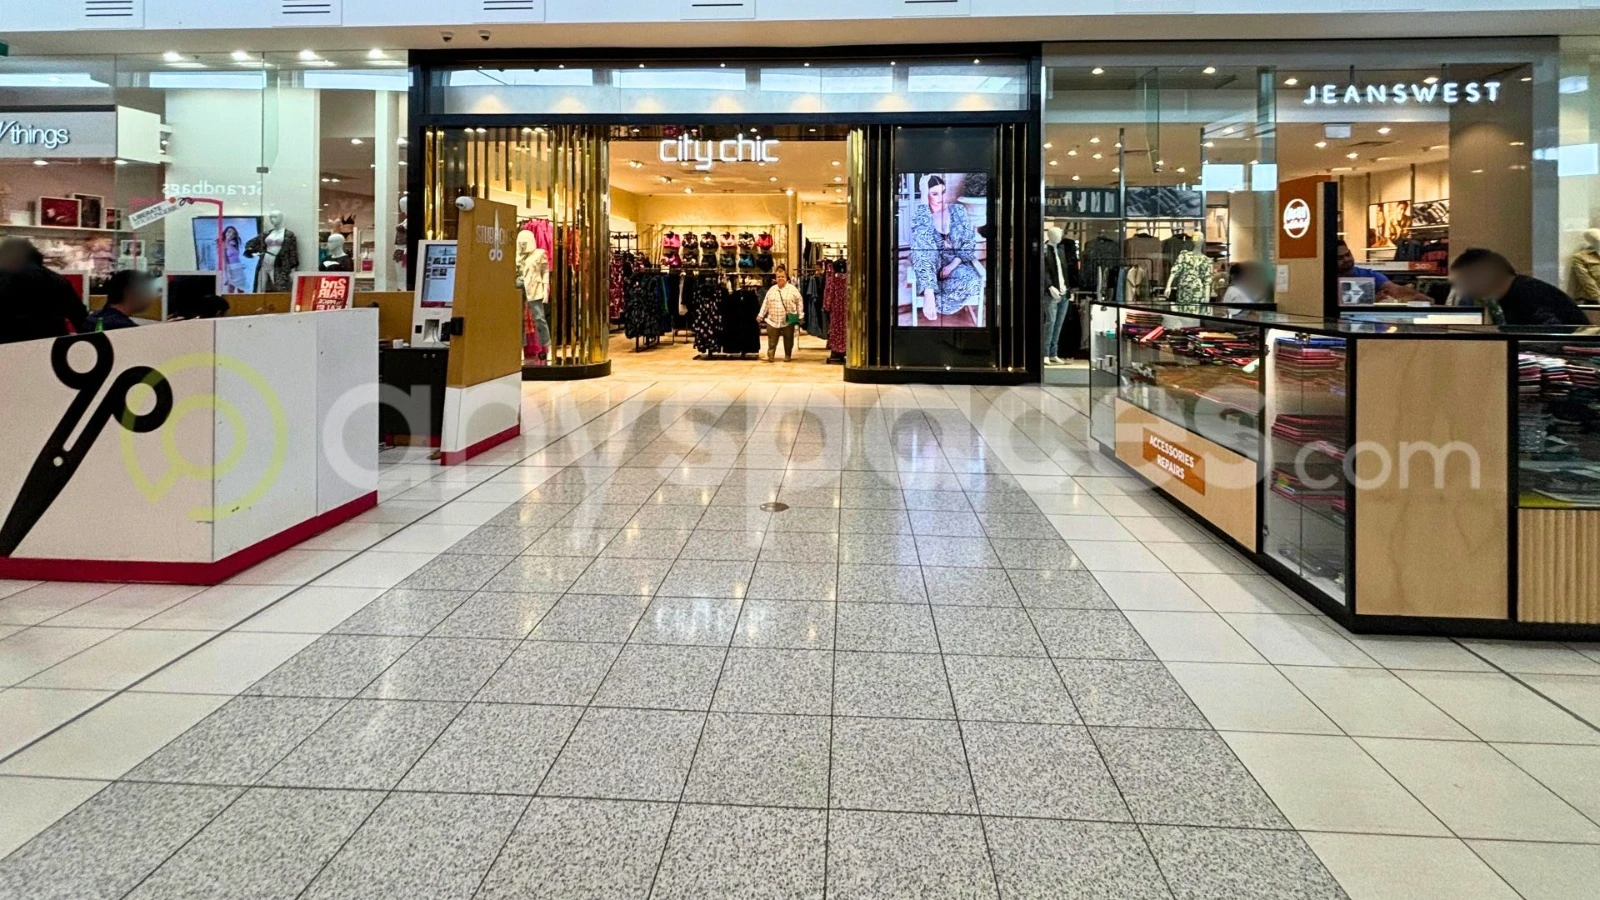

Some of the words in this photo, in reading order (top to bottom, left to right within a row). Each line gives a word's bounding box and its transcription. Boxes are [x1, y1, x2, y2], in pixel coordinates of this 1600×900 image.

[1303, 82, 1500, 104] JEANSWEST
[659, 132, 713, 170] city
[720, 133, 780, 162] chic
[1149, 435, 1194, 468] ACCESSORIES
[1156, 454, 1185, 480] REPAIRS
